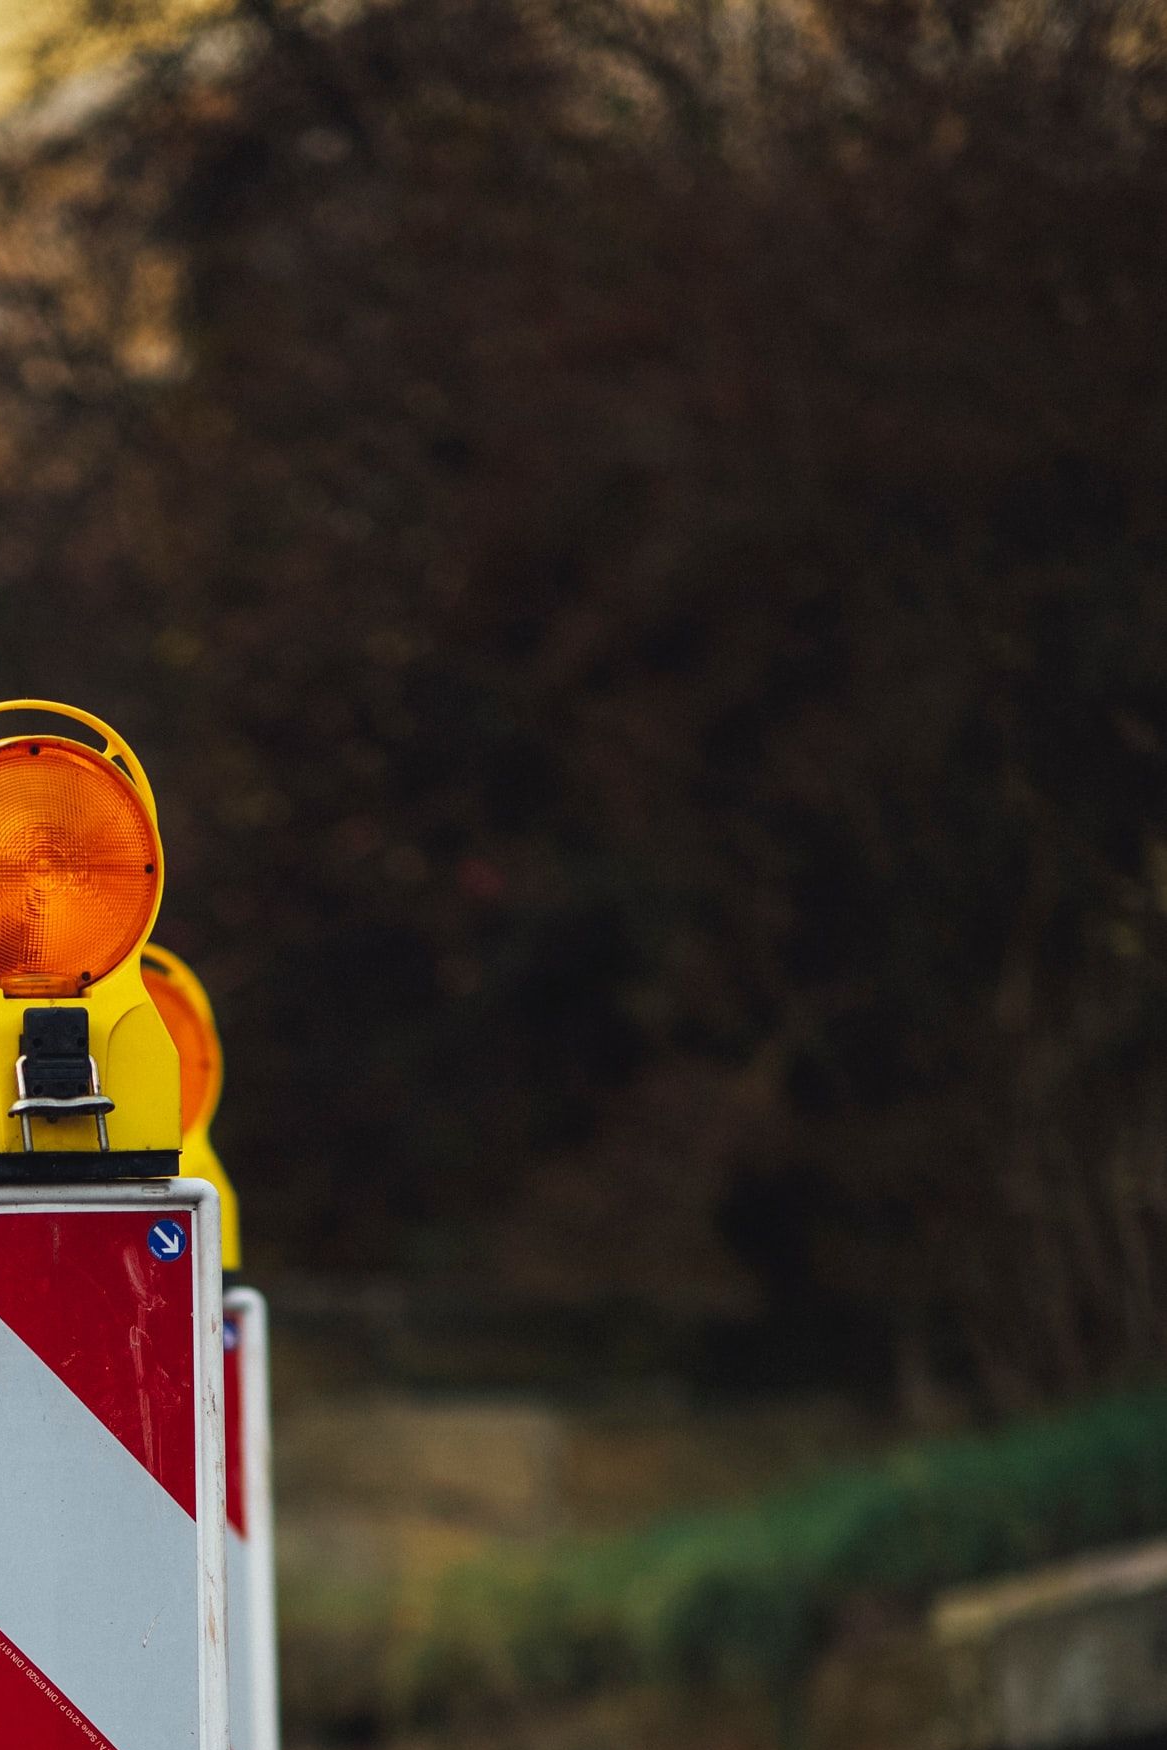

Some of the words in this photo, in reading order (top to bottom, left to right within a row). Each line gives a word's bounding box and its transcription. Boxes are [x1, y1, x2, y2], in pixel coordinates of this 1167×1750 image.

[9, 1652, 25, 1668] DIN
[25, 1668, 47, 1690] 67520
[44, 1687, 59, 1703] DIN
[65, 1709, 83, 1727] 3210
[81, 1723, 98, 1743] Serie
